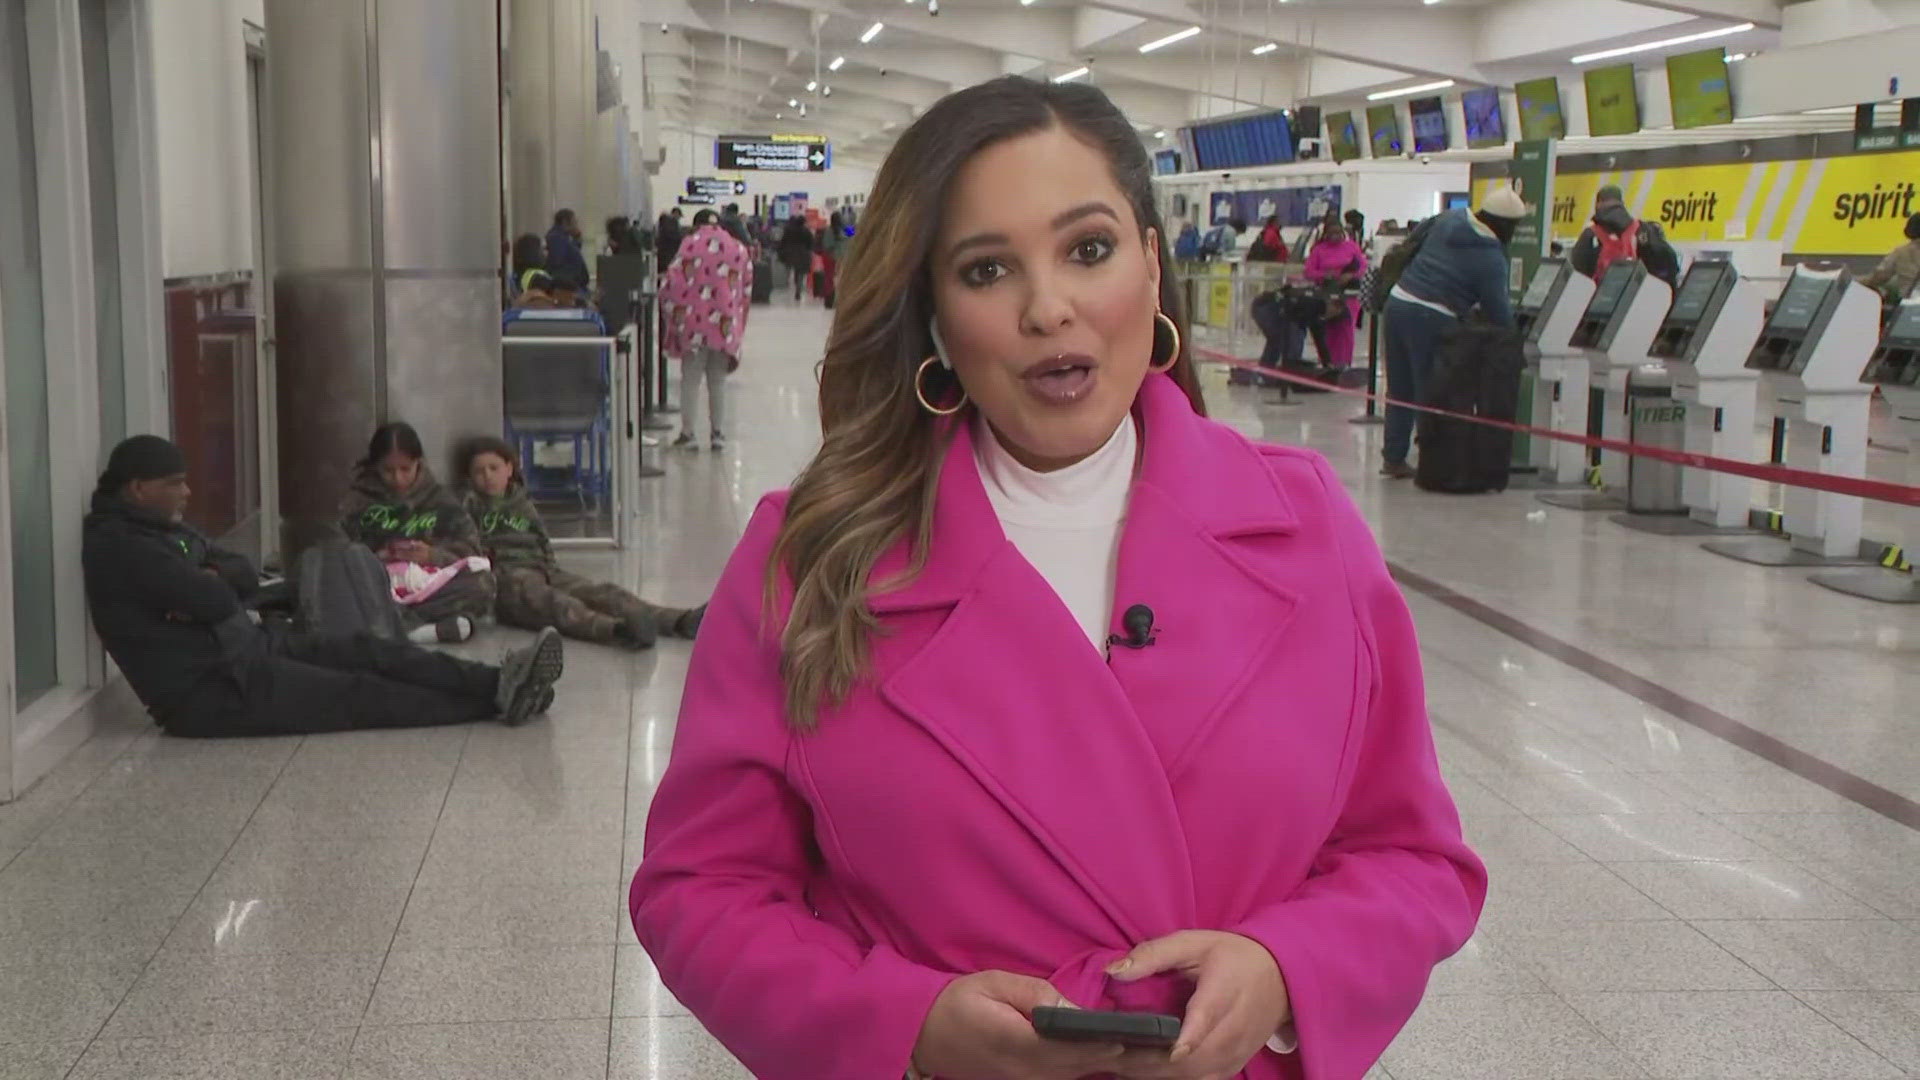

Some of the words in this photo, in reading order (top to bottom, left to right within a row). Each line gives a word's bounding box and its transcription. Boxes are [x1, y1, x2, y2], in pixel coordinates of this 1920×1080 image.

[1552, 196, 1576, 223] irit
[1660, 191, 1718, 229] spirit
[1834, 182, 1915, 229] spirit
